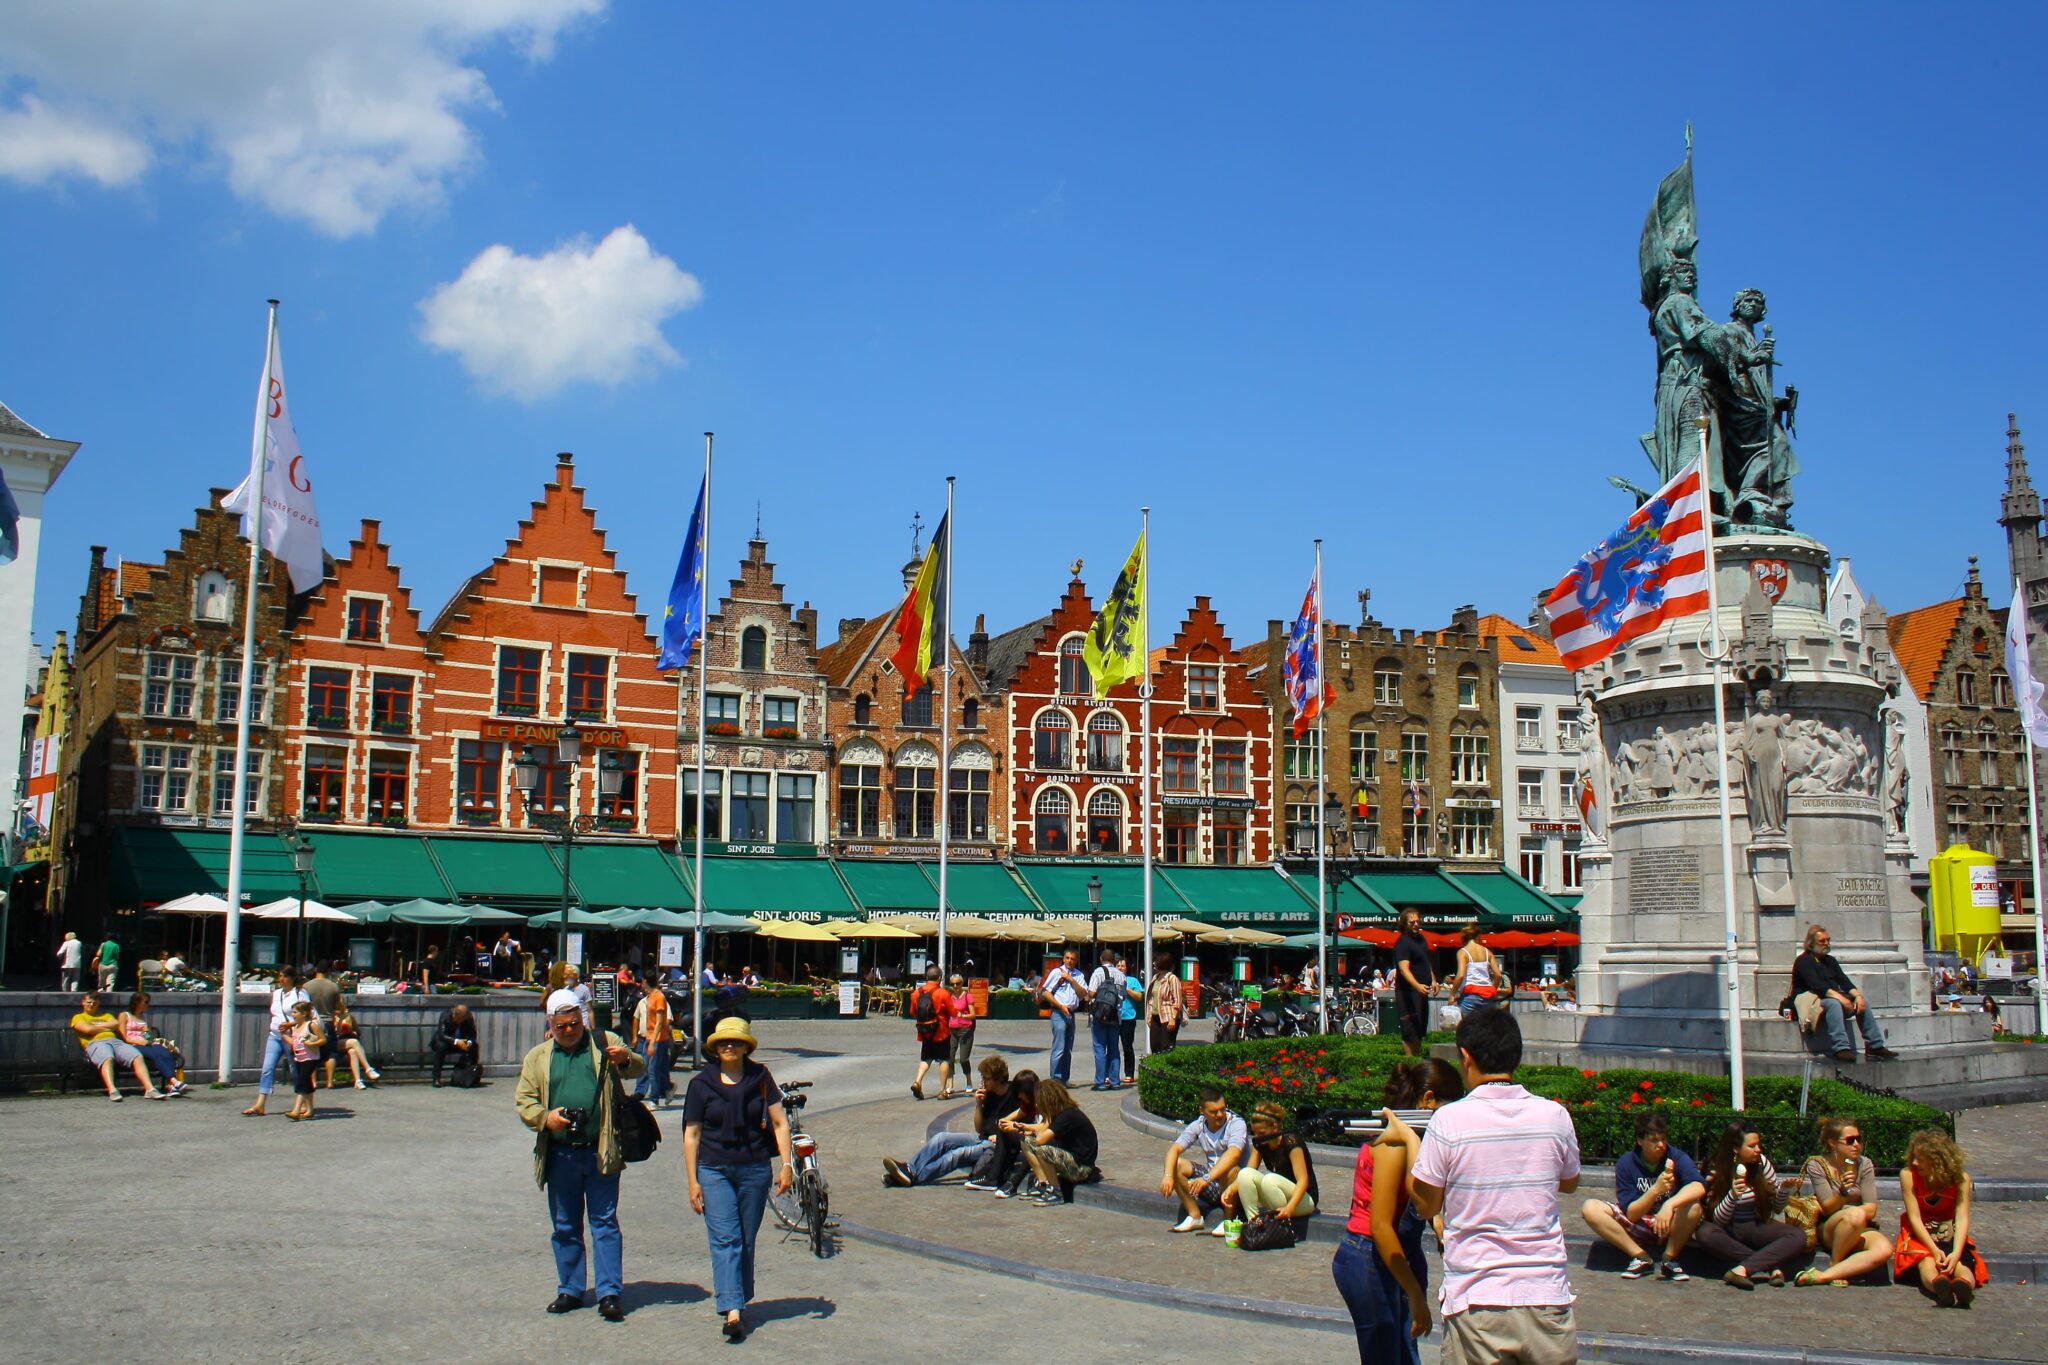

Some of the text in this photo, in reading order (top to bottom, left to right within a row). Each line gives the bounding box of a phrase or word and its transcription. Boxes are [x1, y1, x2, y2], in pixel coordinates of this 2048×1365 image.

[487, 723, 622, 744] LE PANI D'OR
[1024, 773, 1036, 782] de
[1093, 775, 1134, 785] meermin
[1163, 796, 1215, 806] RESTAURANT
[207, 818, 233, 827] Brugeo
[727, 845, 775, 854] SINT JORIS
[849, 844, 986, 856] HOTEL RESTAURANT CENTRAL
[753, 910, 821, 921] SINT-JORIS
[1220, 912, 1310, 921] CAFE DES ARTS
[1444, 915, 1478, 923] Restaurant
[1512, 914, 1555, 922] PETIT CAFE
